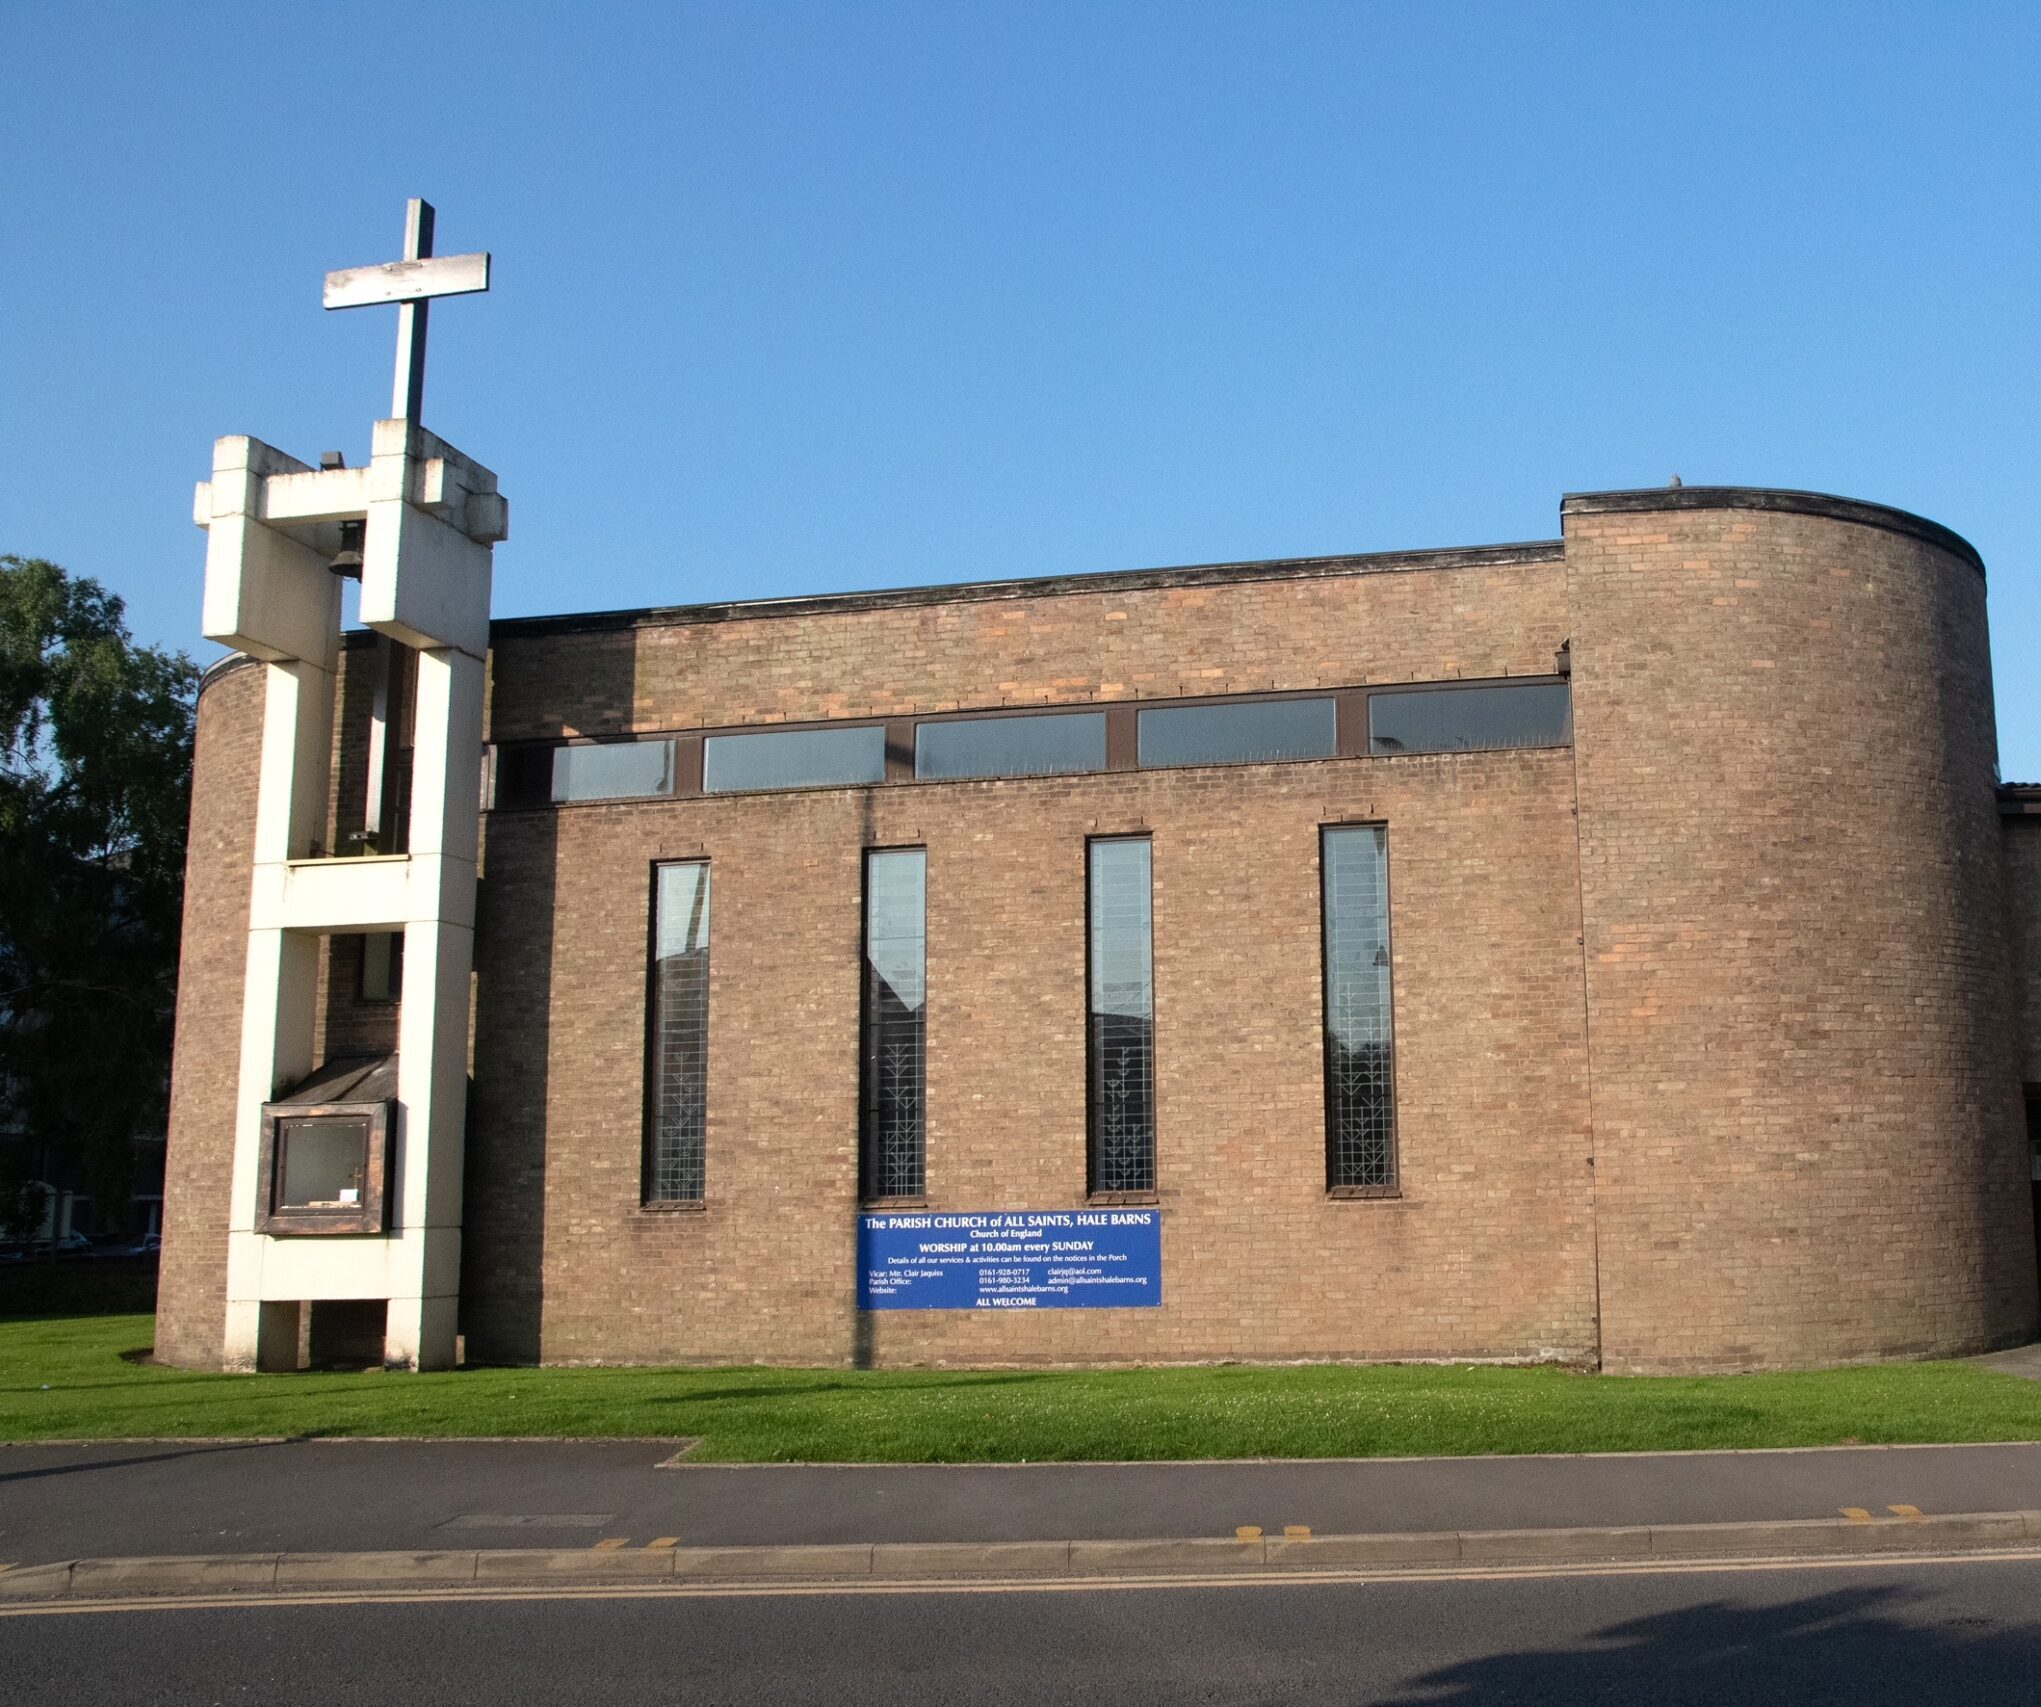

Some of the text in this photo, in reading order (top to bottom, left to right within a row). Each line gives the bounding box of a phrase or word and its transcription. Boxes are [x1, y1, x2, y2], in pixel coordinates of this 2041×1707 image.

[866, 1214, 1151, 1228] The PARISH CHURCH of ALL SAINTS, HALE BARNS
[970, 1230, 998, 1238] Church
[1010, 1229, 1042, 1239] England
[919, 1244, 967, 1252] WORSHIP
[982, 1243, 1021, 1251] 10.00am
[1024, 1243, 1050, 1253] every
[1052, 1241, 1094, 1250] SUNDAY
[920, 1270, 943, 1278] Jaquiss
[976, 1298, 1036, 1306] ALL WELCOME
